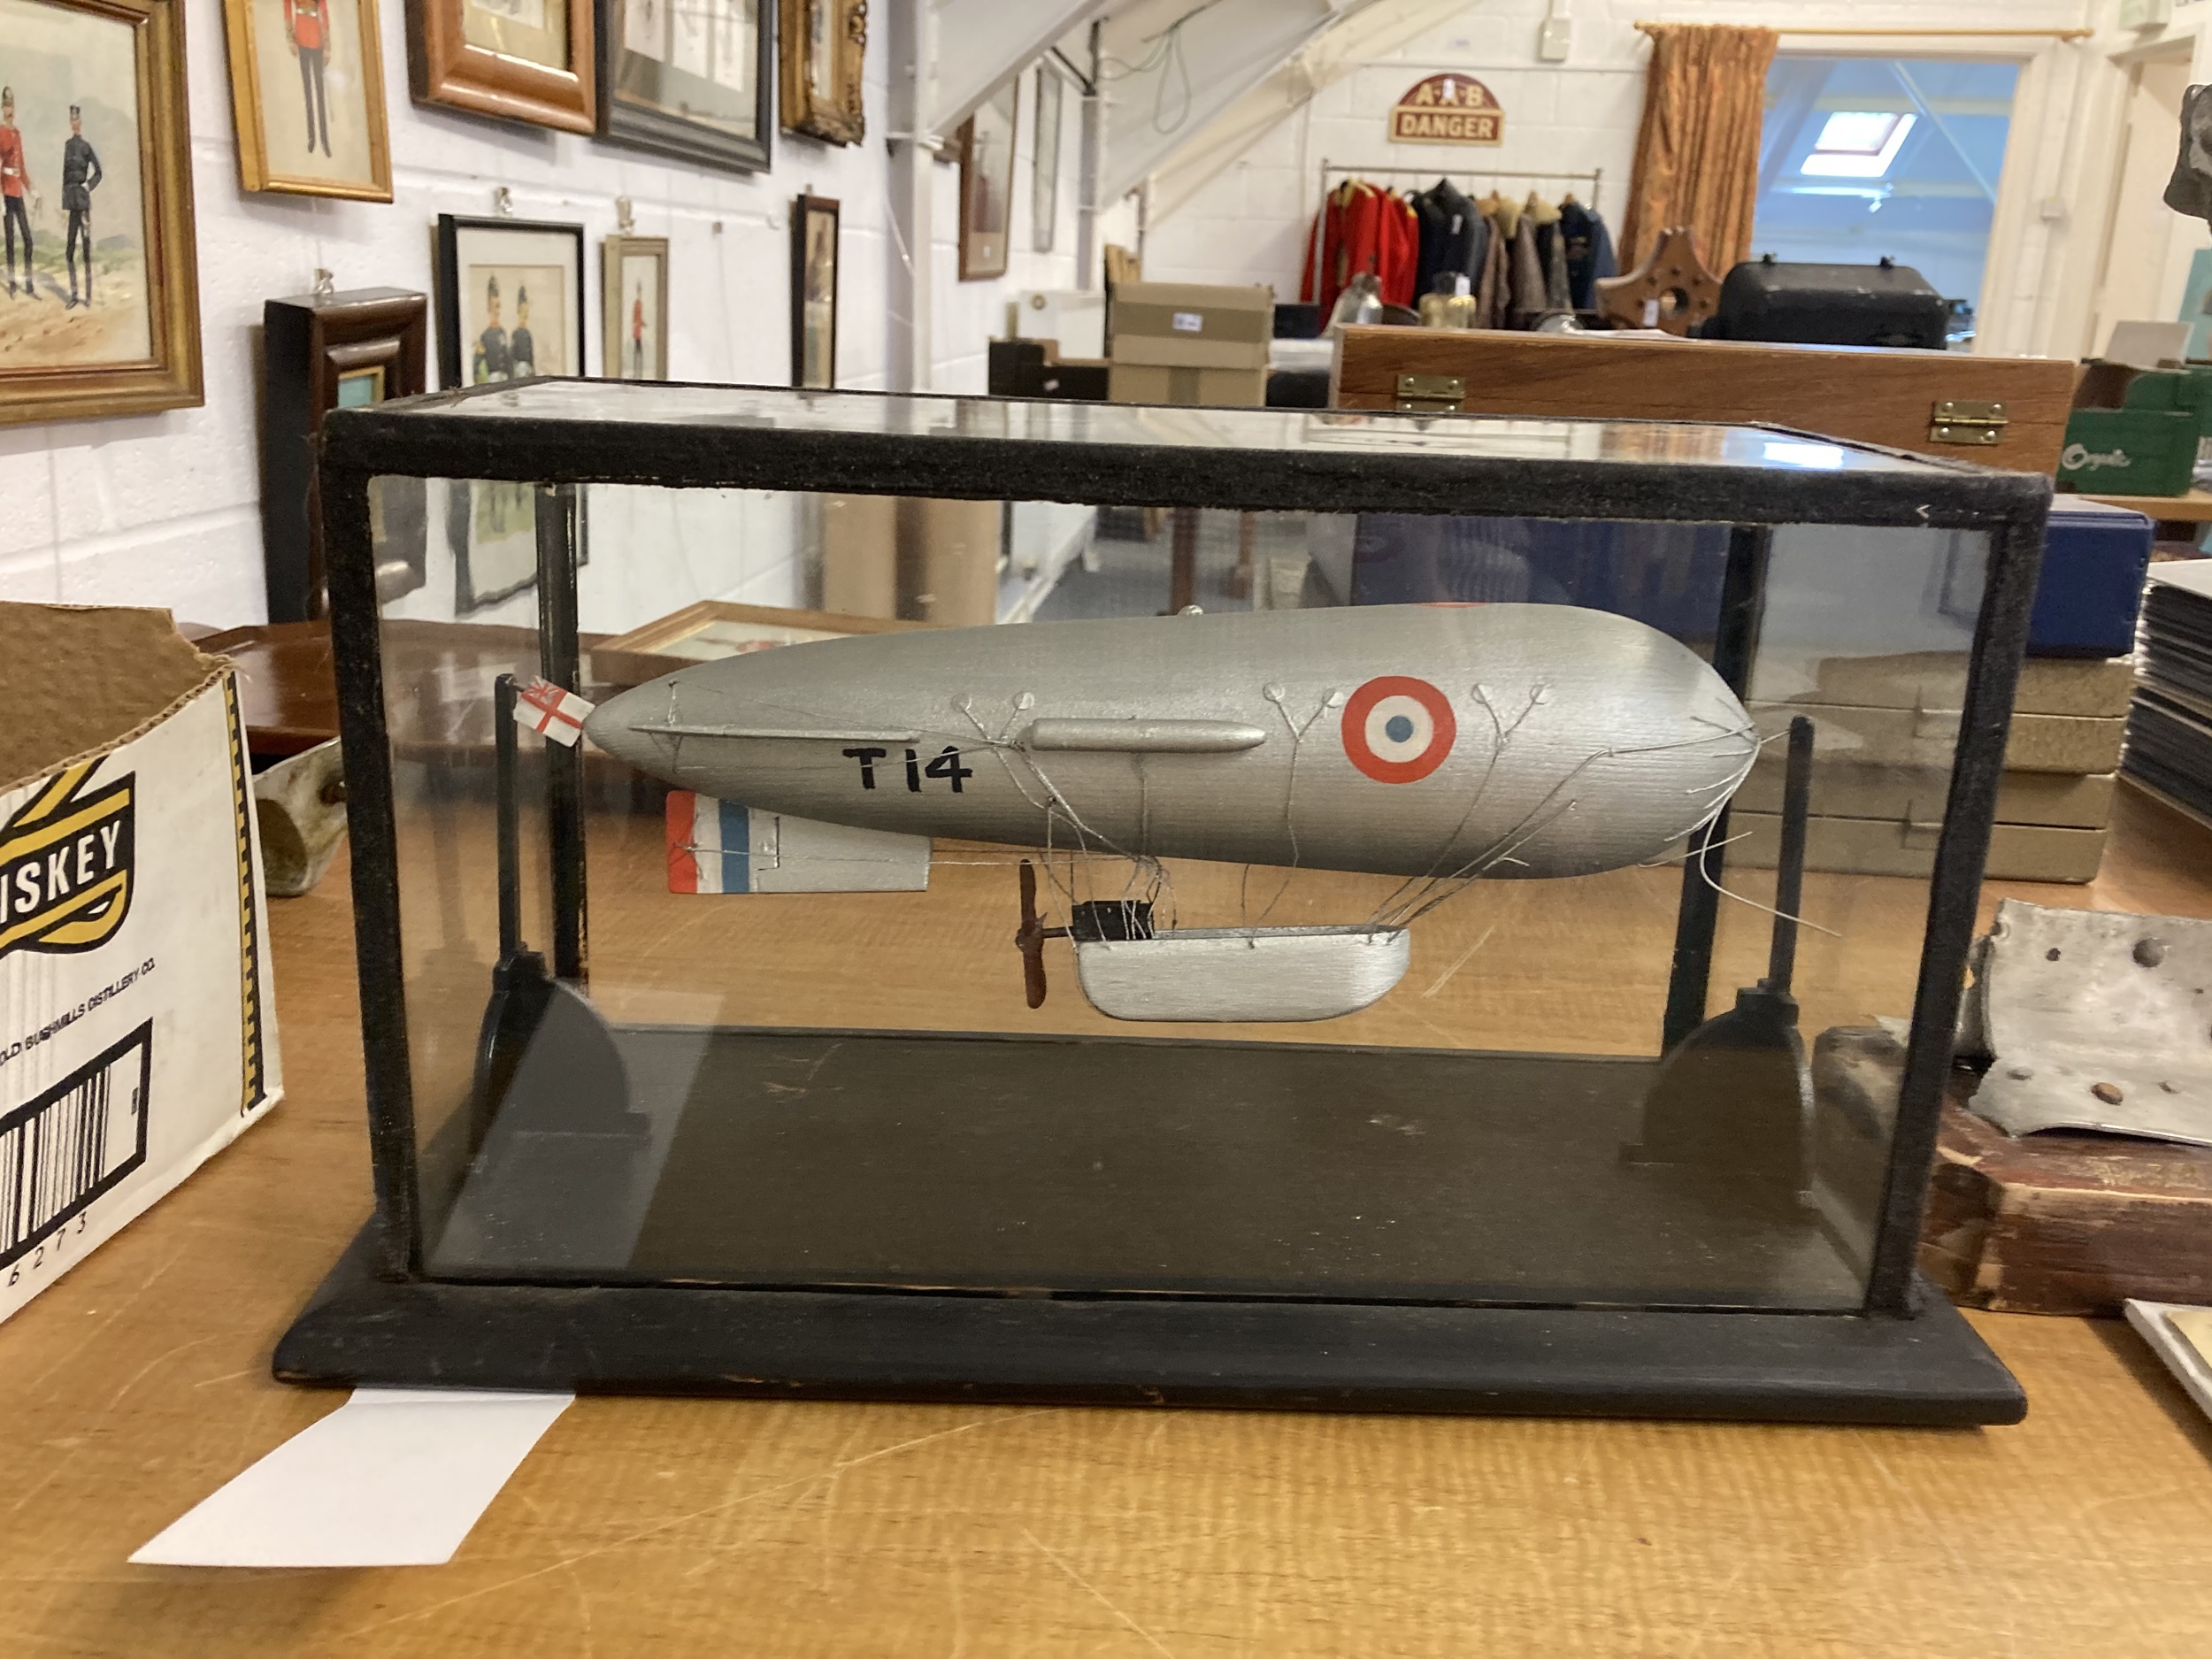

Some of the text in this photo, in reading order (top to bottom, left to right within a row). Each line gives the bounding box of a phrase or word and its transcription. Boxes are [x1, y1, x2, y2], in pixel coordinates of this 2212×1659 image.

[1401, 114, 1494, 138] DANGER
[25, 1003, 86, 1050] BUSHMILLS
[88, 967, 140, 1011] DISTILLERY
